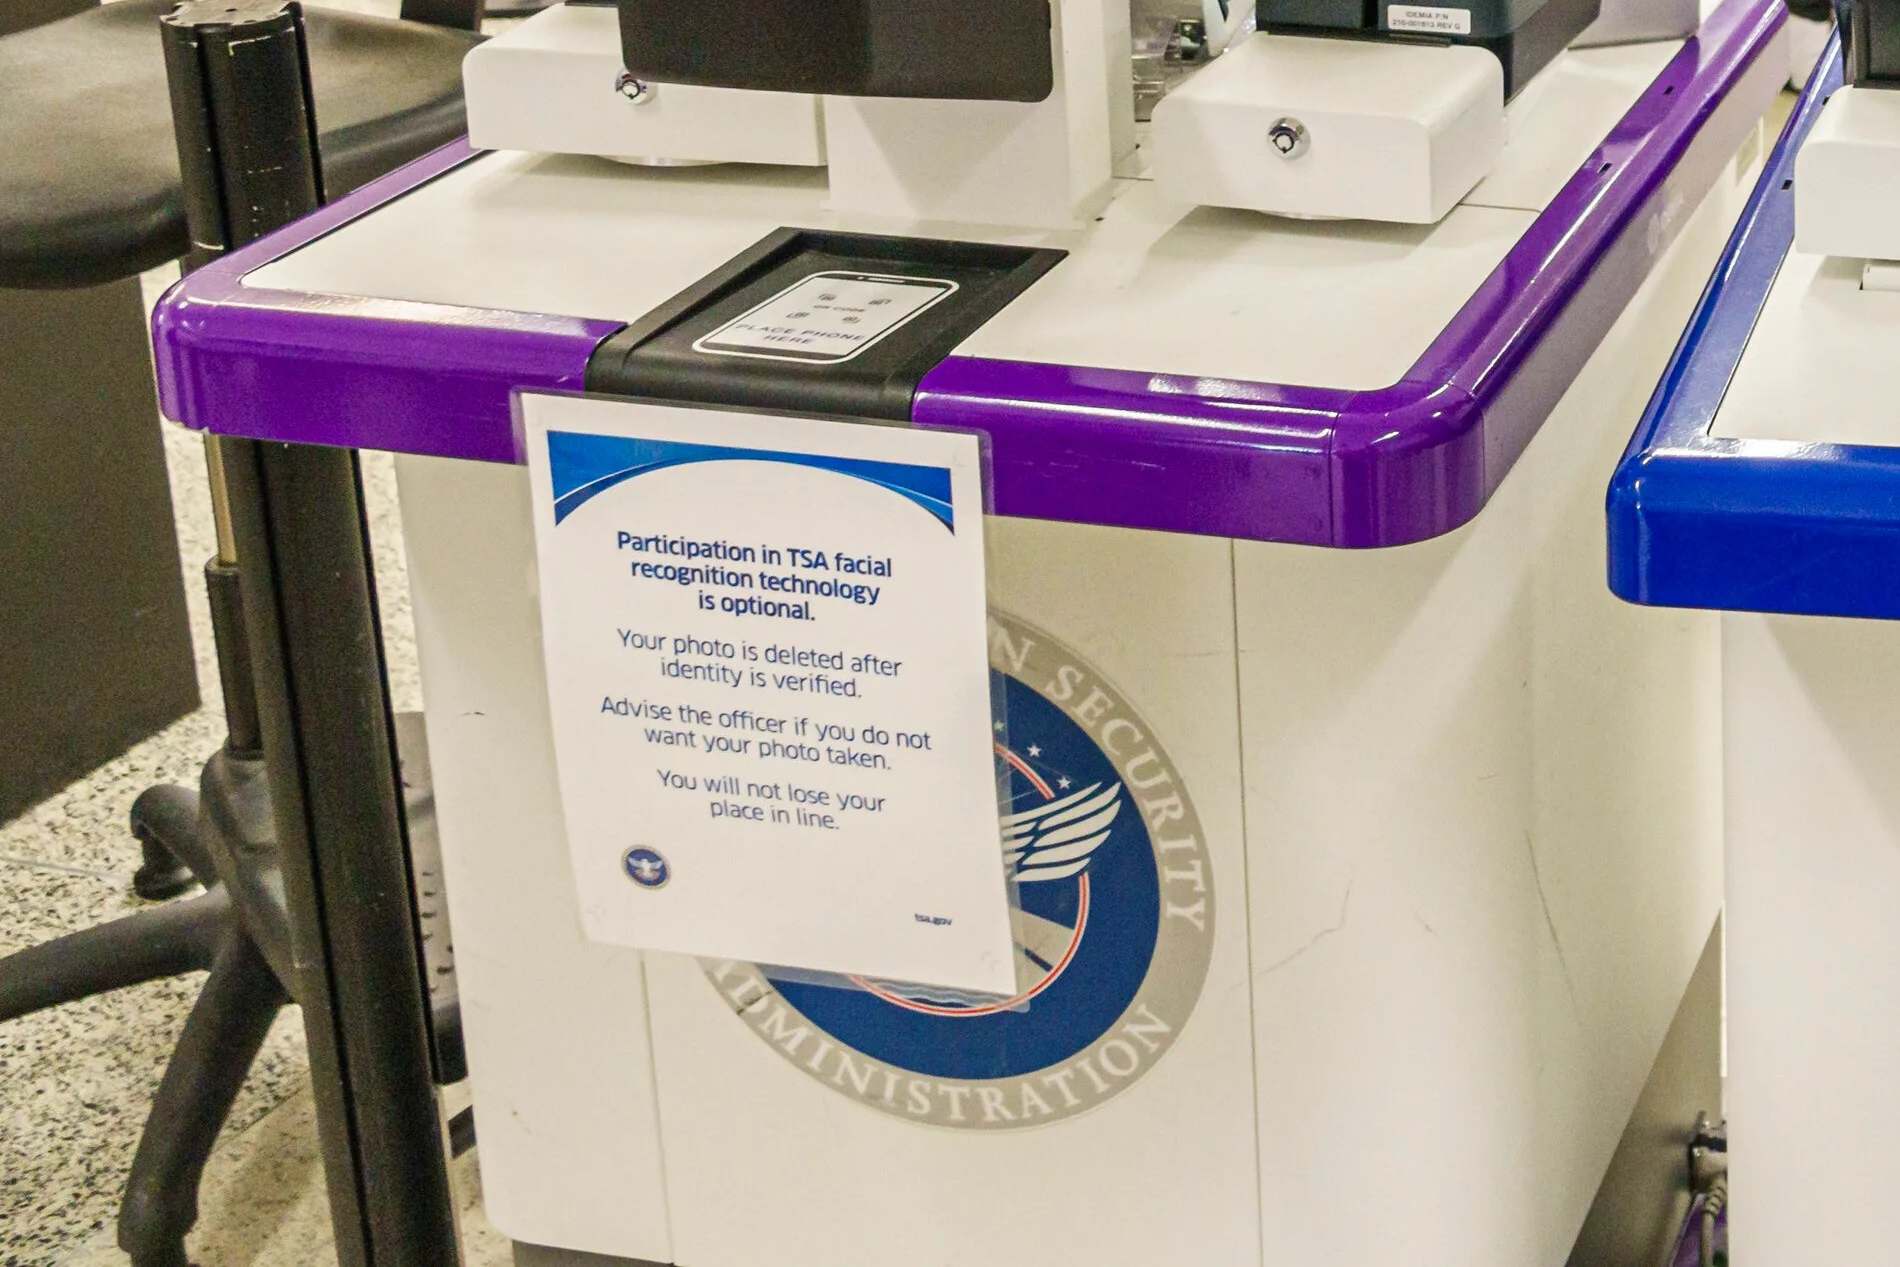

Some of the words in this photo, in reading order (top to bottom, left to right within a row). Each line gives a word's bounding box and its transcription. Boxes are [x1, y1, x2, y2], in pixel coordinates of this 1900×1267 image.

[735, 324, 800, 335] PLACE
[806, 330, 867, 341] PHONE
[763, 335, 812, 345] HERE
[617, 531, 756, 563] Participation
[762, 546, 782, 566] in
[786, 548, 830, 571] TSA
[834, 552, 892, 578] facial
[631, 562, 754, 593] recognition
[757, 571, 880, 606] technology
[699, 589, 716, 610] is
[721, 596, 815, 621] optional.
[617, 628, 667, 650] Your
[673, 634, 735, 659] photo
[742, 641, 759, 661] is
[764, 644, 843, 670] deleted
[851, 654, 903, 676] after
[661, 657, 743, 688] identity
[750, 667, 766, 687] is
[772, 673, 862, 698] verified.
[601, 696, 672, 721] Advise
[678, 705, 712, 726] the
[719, 710, 787, 733] officer
[795, 717, 808, 736] if
[815, 724, 855, 742] you
[862, 725, 889, 746] do
[896, 732, 932, 750] not
[644, 728, 696, 748] want
[702, 735, 751, 754] your
[759, 739, 820, 762] photo
[826, 746, 891, 770] taken.
[657, 769, 697, 790] You
[703, 776, 740, 794] will
[747, 783, 782, 800] not
[788, 784, 830, 806] lose
[836, 793, 886, 811] your
[1045, 665, 1205, 933] SECURITY
[710, 800, 764, 821] place
[771, 805, 790, 824] in
[796, 808, 839, 829] line.
